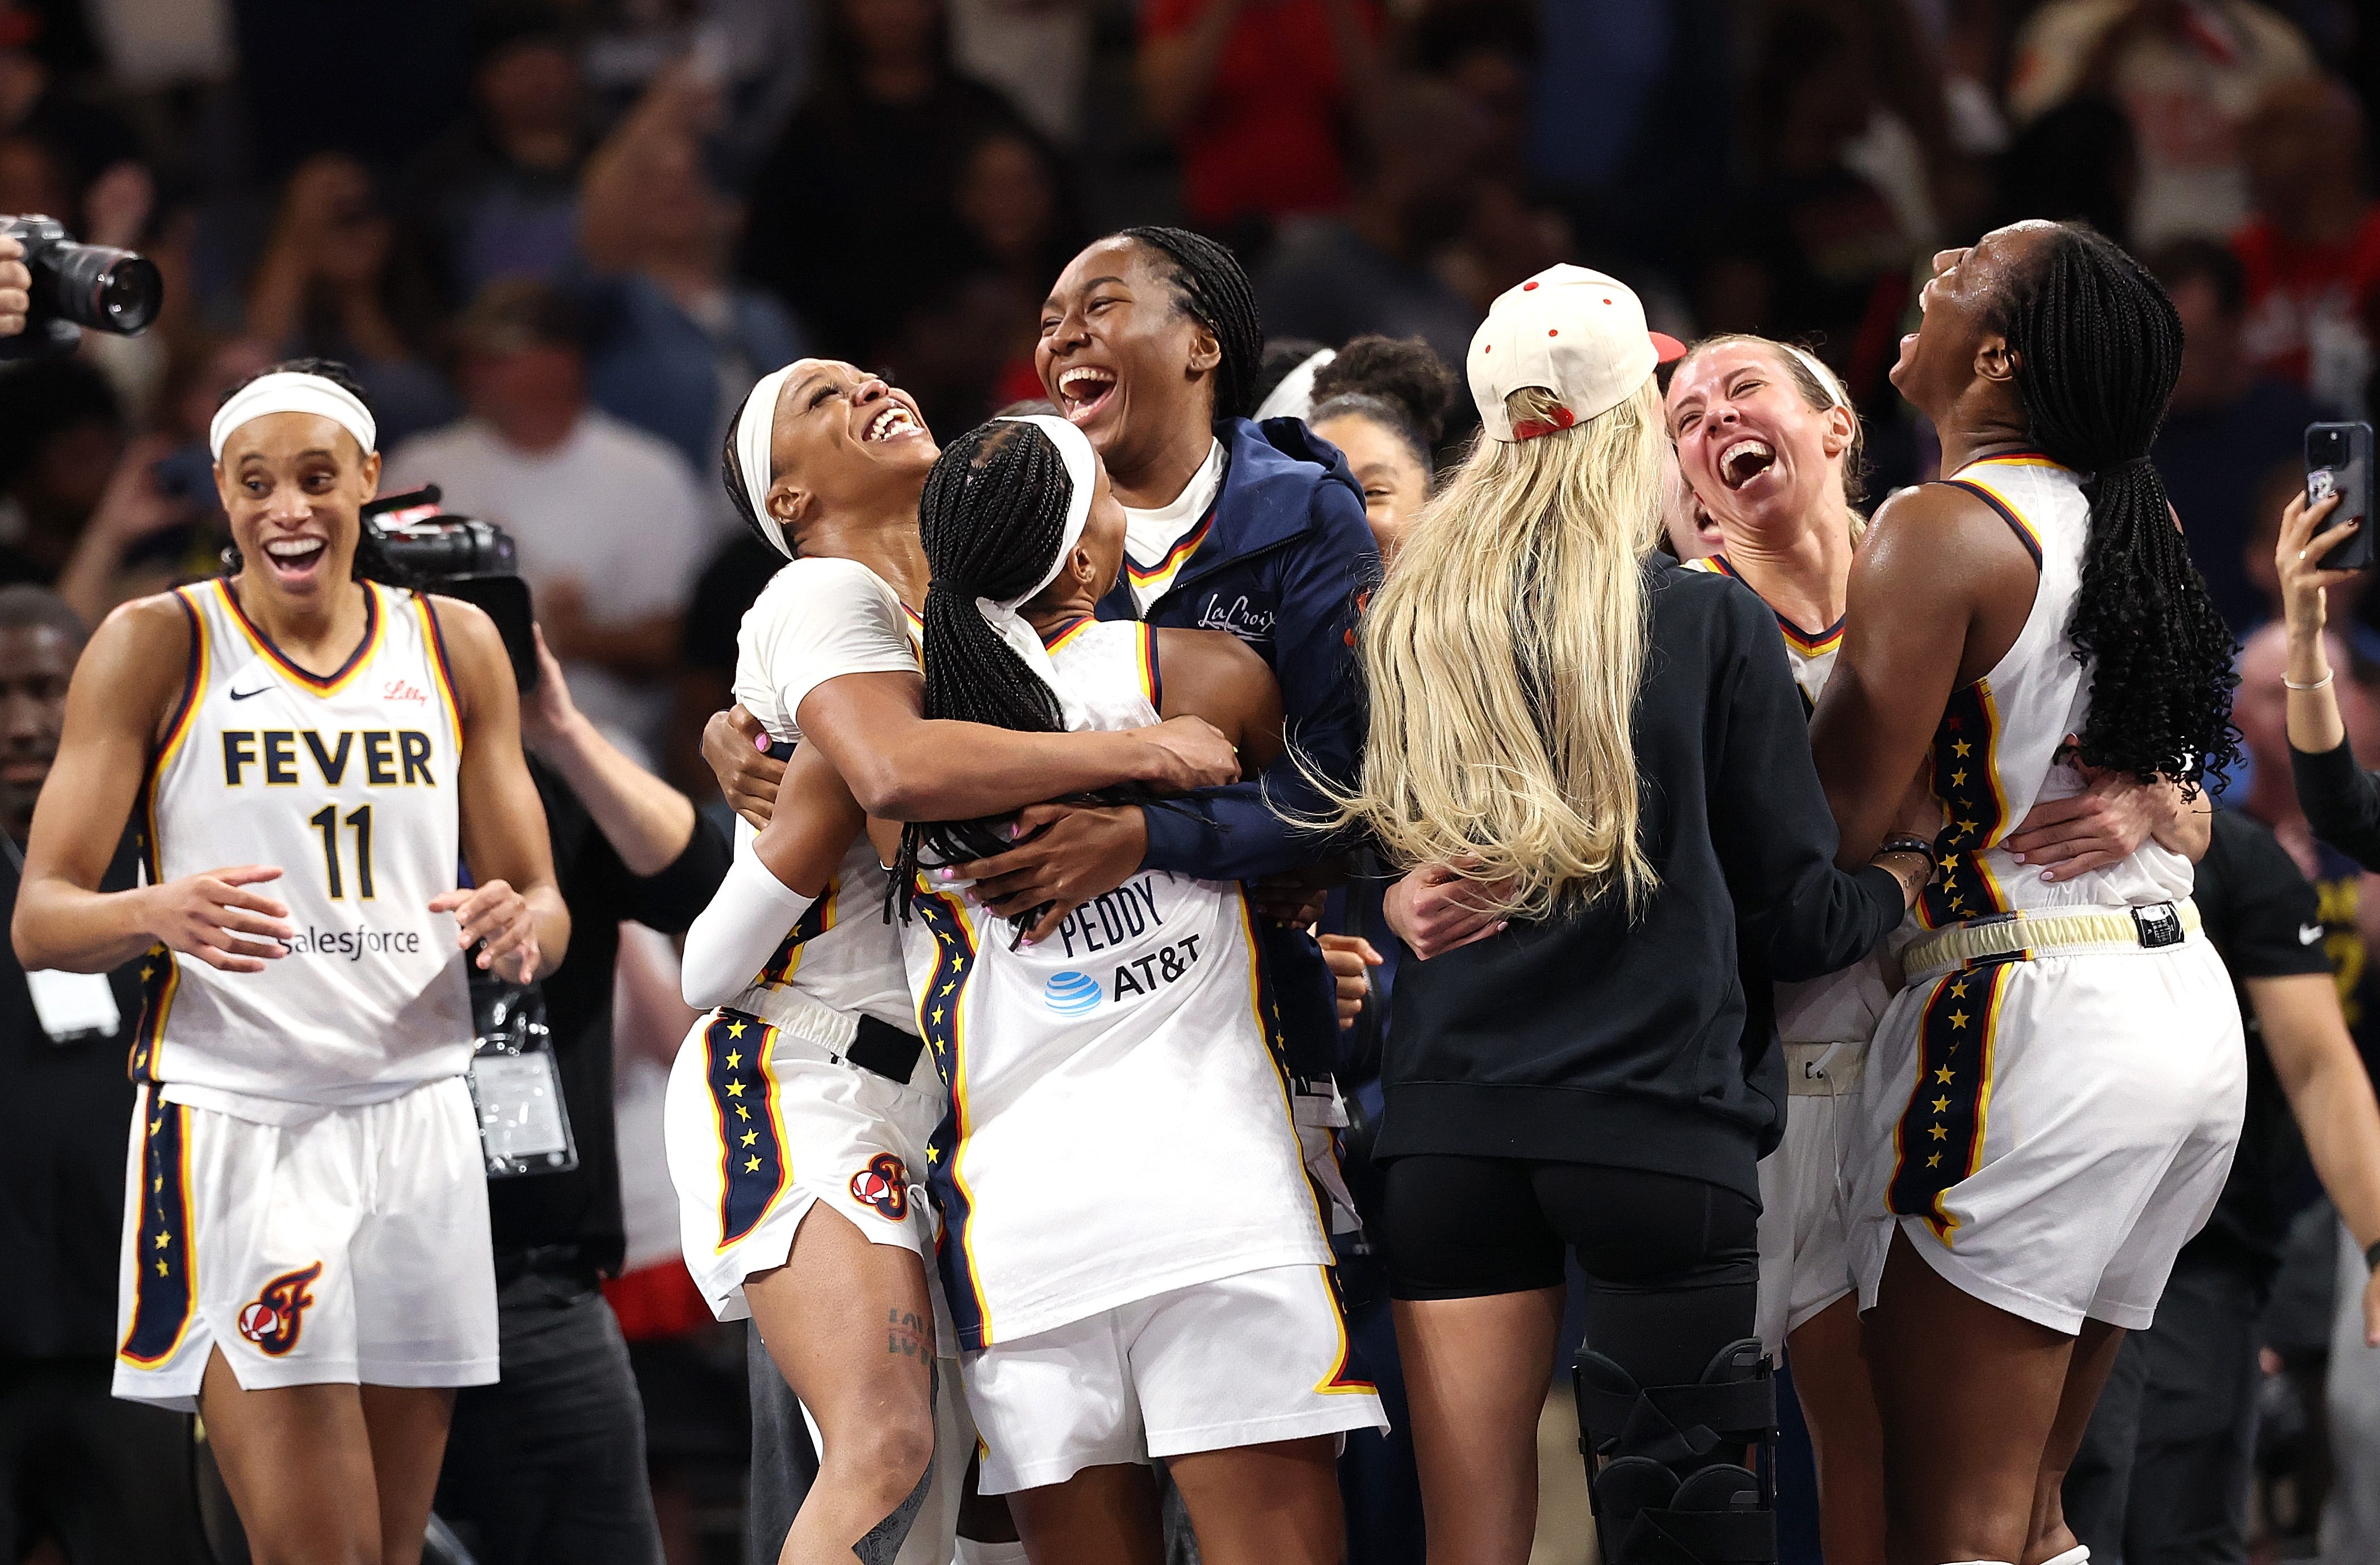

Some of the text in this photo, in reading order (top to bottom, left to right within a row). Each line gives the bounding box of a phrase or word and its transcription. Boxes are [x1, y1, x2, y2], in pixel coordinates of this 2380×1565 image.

[384, 680, 428, 707] Lilly
[221, 729, 436, 788] FEVER
[310, 803, 375, 900] 11
[1058, 876, 1162, 958] PEDDY
[1114, 933, 1199, 1002] AT&T
